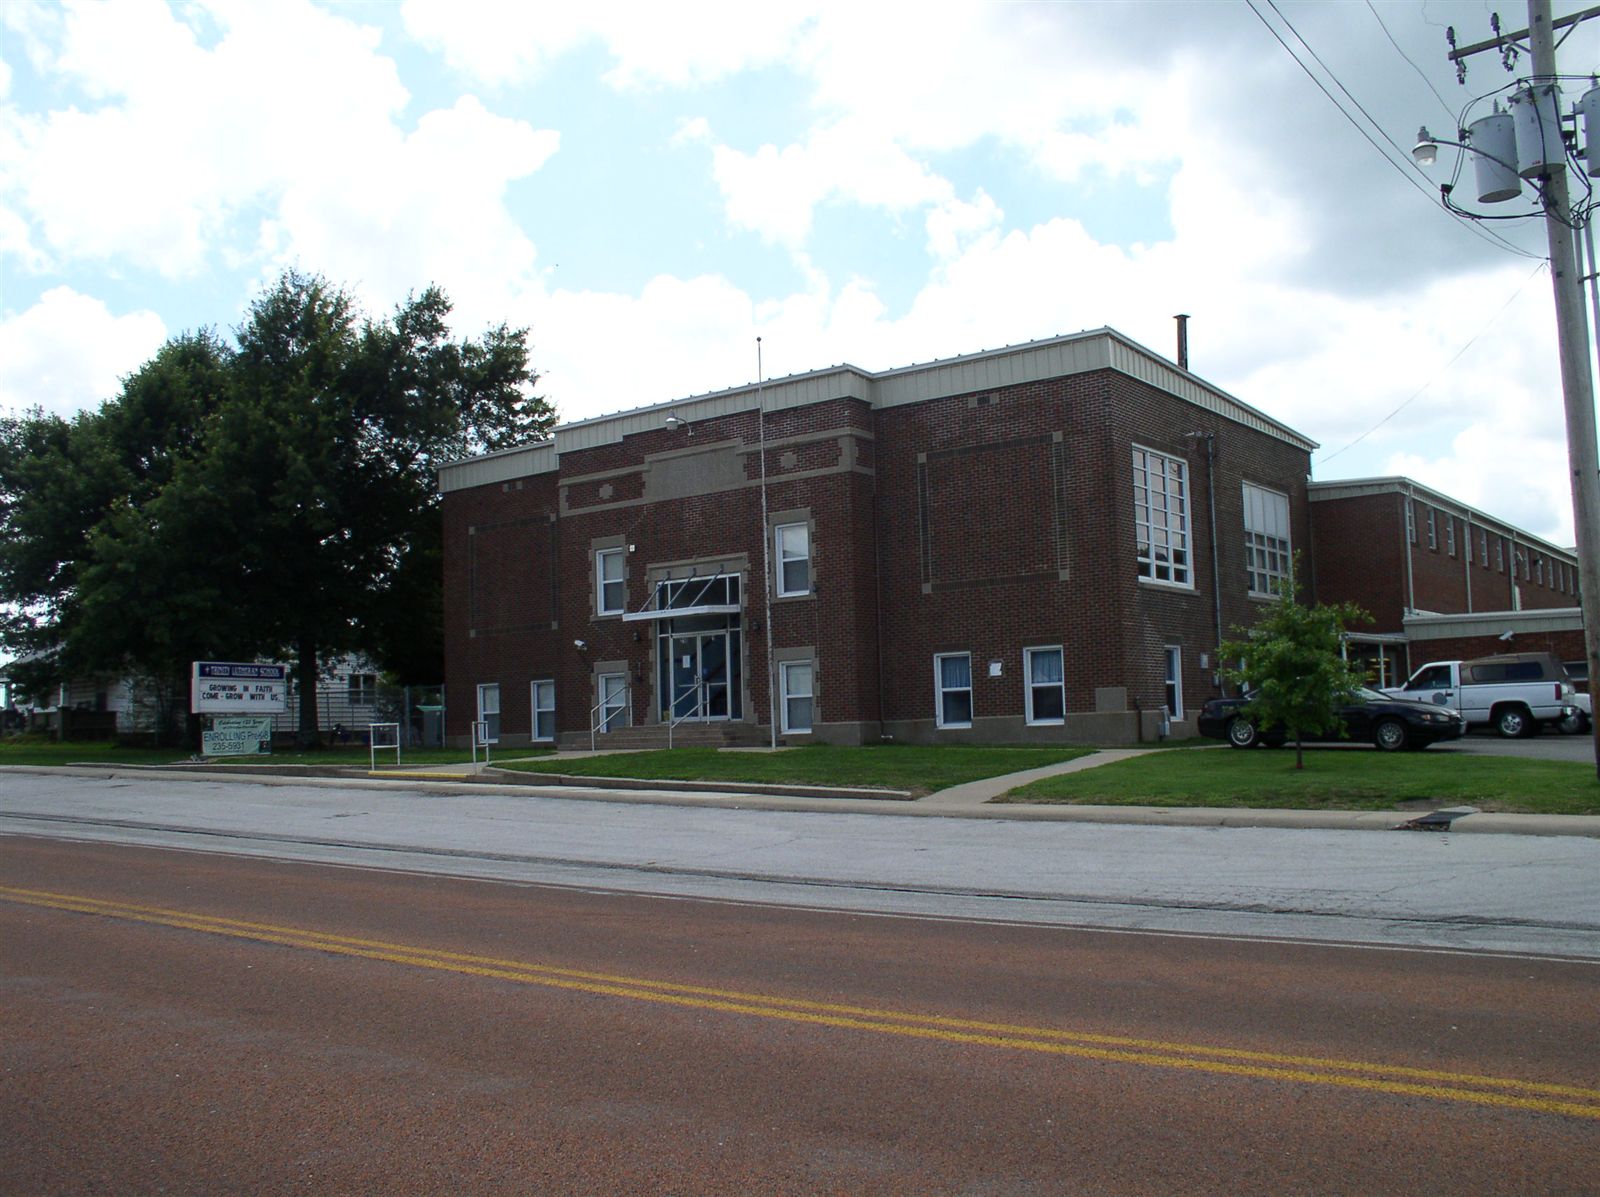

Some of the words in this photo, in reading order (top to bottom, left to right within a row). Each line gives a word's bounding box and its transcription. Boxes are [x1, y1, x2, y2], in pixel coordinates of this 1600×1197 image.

[209, 684, 237, 692] GROWING
[255, 685, 273, 693] FAITH
[250, 693, 265, 701] WITH
[204, 731, 246, 742] ENROLLING
